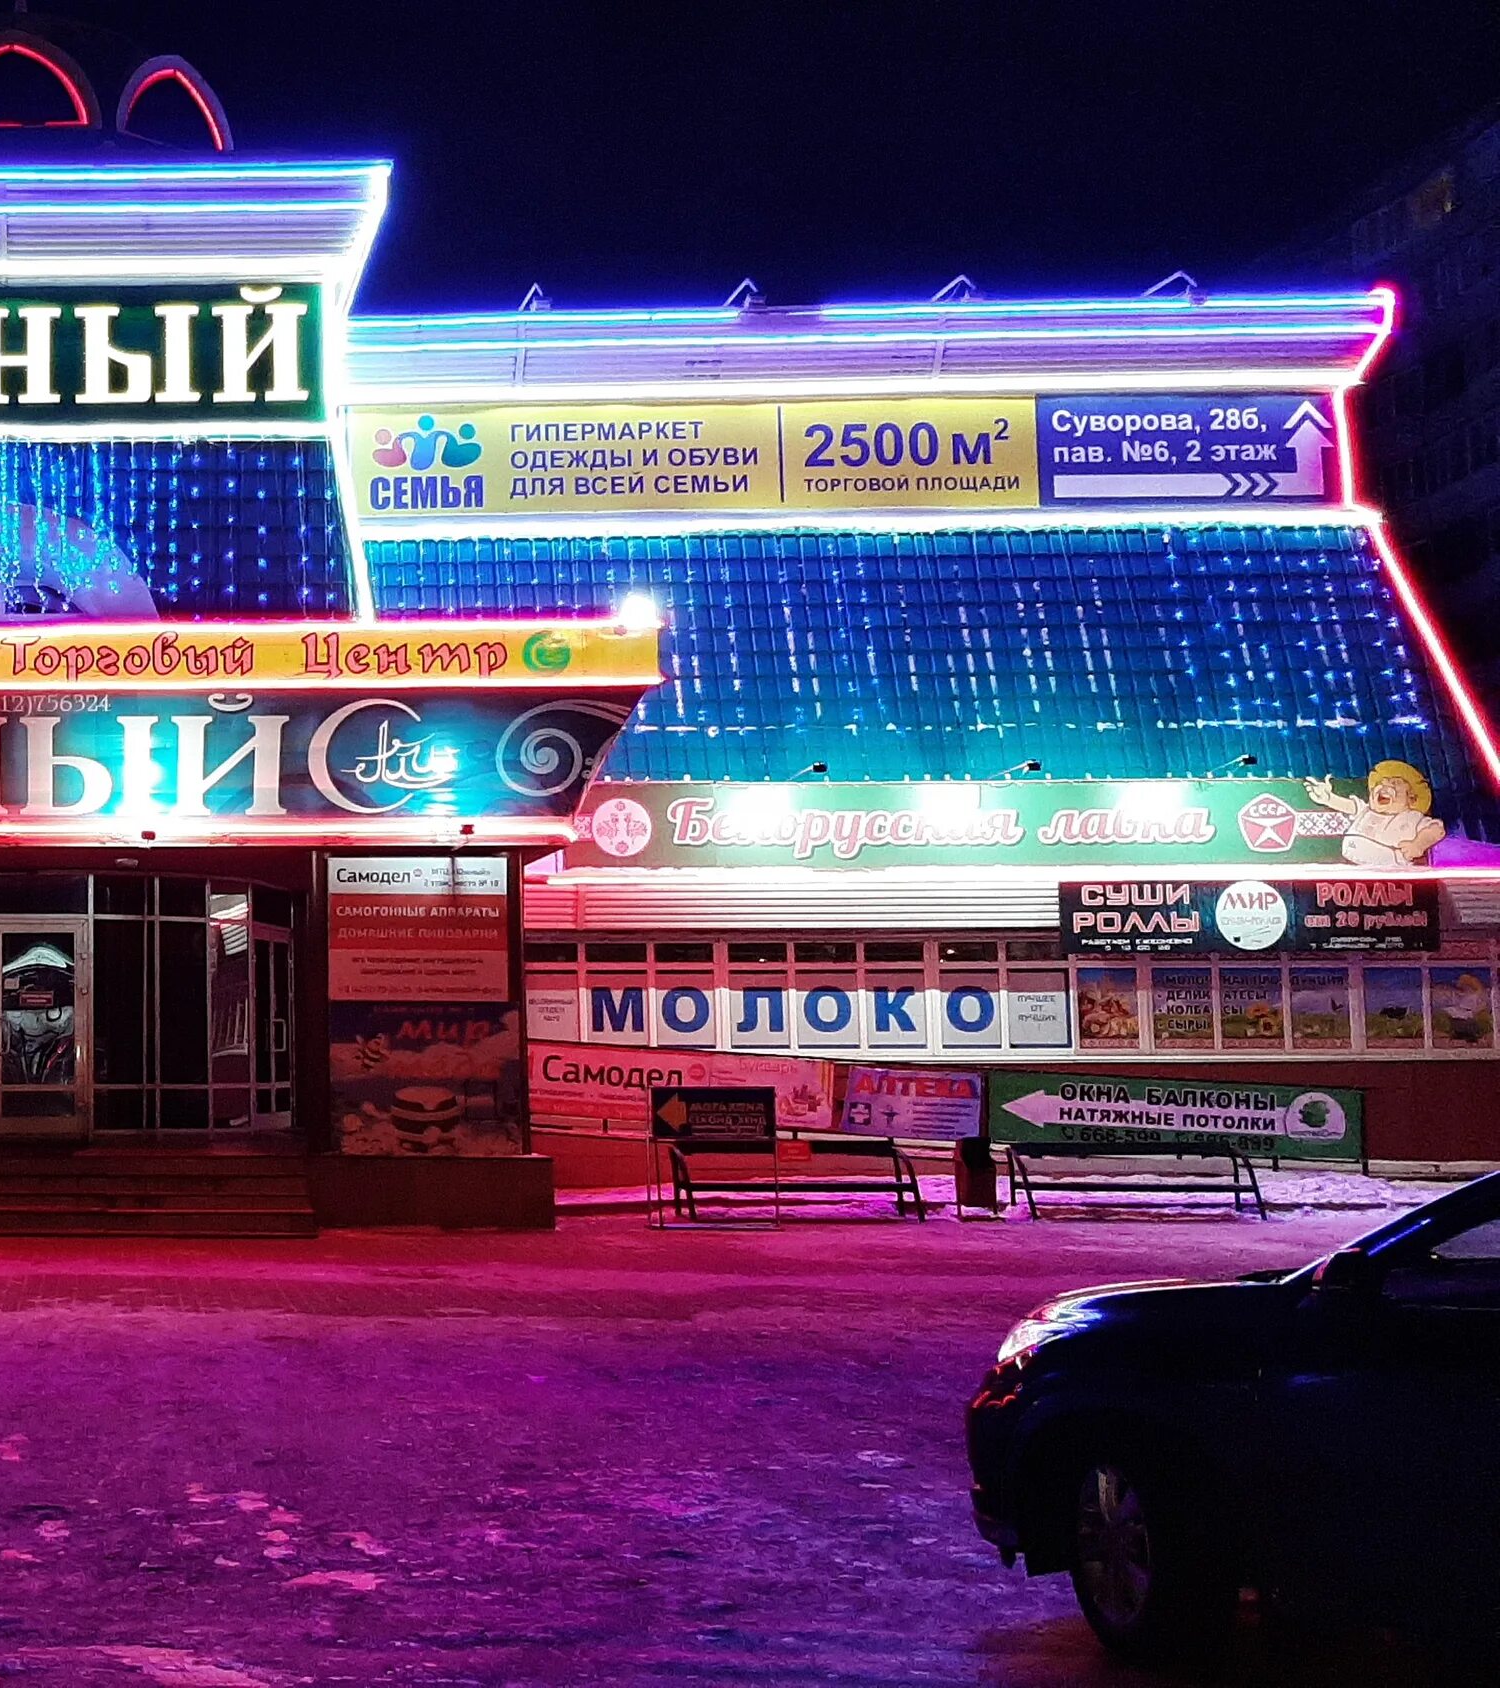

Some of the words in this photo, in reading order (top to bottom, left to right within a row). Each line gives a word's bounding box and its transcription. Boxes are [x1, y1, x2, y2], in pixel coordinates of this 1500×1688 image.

[510, 421, 705, 443] ГИПЕРМАРКЕТ
[1051, 408, 1202, 436] Суворова,
[1209, 408, 1269, 434] 28б,
[803, 421, 940, 469] 2500
[1053, 444, 1113, 465] пав.
[1122, 441, 1177, 466] №6,
[1185, 442, 1201, 463] 2
[1211, 443, 1278, 463] этаж
[510, 448, 634, 473] ОДЕЖДЫ
[642, 448, 660, 467] И
[667, 447, 759, 467] ОБУВИ
[370, 475, 485, 510] СЕМЬЯ
[509, 477, 565, 499] ДЛЯ
[574, 472, 646, 495] ВСЕЙ
[654, 474, 750, 495] СЕМЬИ
[803, 474, 917, 493] ТОРГОВОЙ
[921, 474, 1020, 494] ПЛОЩАДИ
[2, 631, 254, 682] Торговый
[301, 632, 508, 678] Центр
[1249, 803, 1287, 817] СССР
[667, 796, 1027, 859] Беорусская
[1037, 808, 1217, 846] лавка
[336, 867, 411, 886] Самодел
[1081, 883, 1190, 906] СУШИ
[1222, 891, 1278, 911] МИР
[1316, 881, 1413, 907] РОЛЛЫ
[336, 906, 426, 918] САМОГОННЫЕ
[430, 906, 500, 918] АППАРАТЫ
[1072, 910, 1200, 934] РОЛЛЫ
[337, 927, 414, 939] ДОМАШНИЕ
[591, 984, 996, 1034] МОЛОКО
[1166, 1004, 1244, 1015] КОЛБАСЫ
[1167, 1019, 1207, 1030] СЫРЫ
[542, 1054, 684, 1090] Самодел
[855, 1073, 974, 1098] АПТЕКА
[1060, 1083, 1131, 1105] ОКНА
[1146, 1088, 1277, 1112] БАЛКОНЫ
[1058, 1106, 1175, 1127] НАТЯЖНЫЕ
[1182, 1113, 1277, 1132] ПОТОЛКИ
